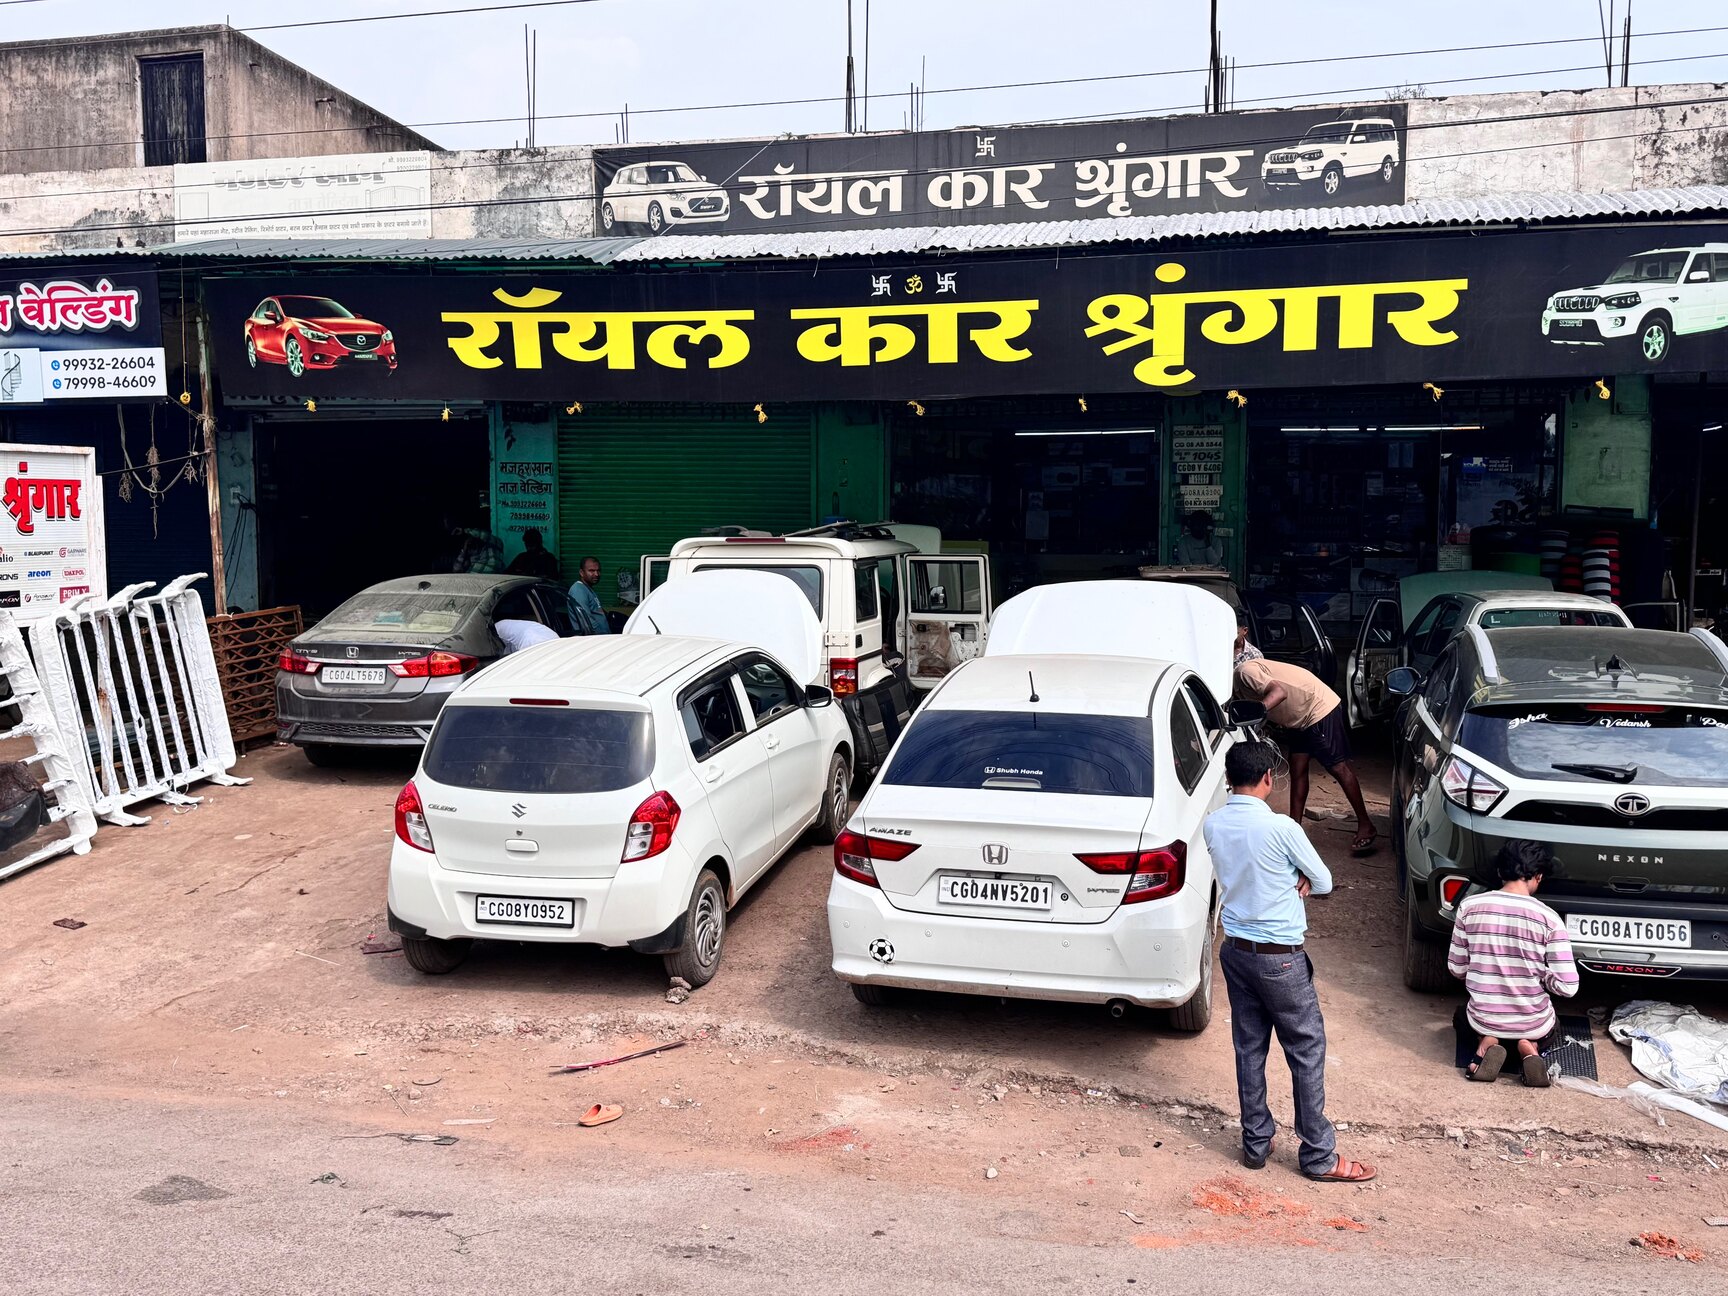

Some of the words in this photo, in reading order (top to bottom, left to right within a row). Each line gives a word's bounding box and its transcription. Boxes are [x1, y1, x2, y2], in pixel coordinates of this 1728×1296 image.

[738, 165, 908, 217] रॉयल
[928, 163, 1055, 209] कार
[19, 281, 135, 325] वेल्डिंग
[442, 289, 754, 369] रॉयल
[792, 300, 1038, 366] कार
[63, 357, 155, 371] 99932-26604
[64, 376, 156, 390] 79998-46609
[1192, 451, 1221, 461] 1045
[329, 671, 384, 681] CG04LT5678
[1600, 718, 1651, 728] Vedansh
[996, 767, 1019, 775] Shubh
[869, 826, 912, 836] AMAZE
[1598, 854, 1664, 865] NEXON
[951, 881, 1048, 904] CG04NV5201
[489, 902, 564, 919] CG08Y0952
[1580, 919, 1687, 941] CG08AT6056
[1606, 964, 1654, 973] NEXON
